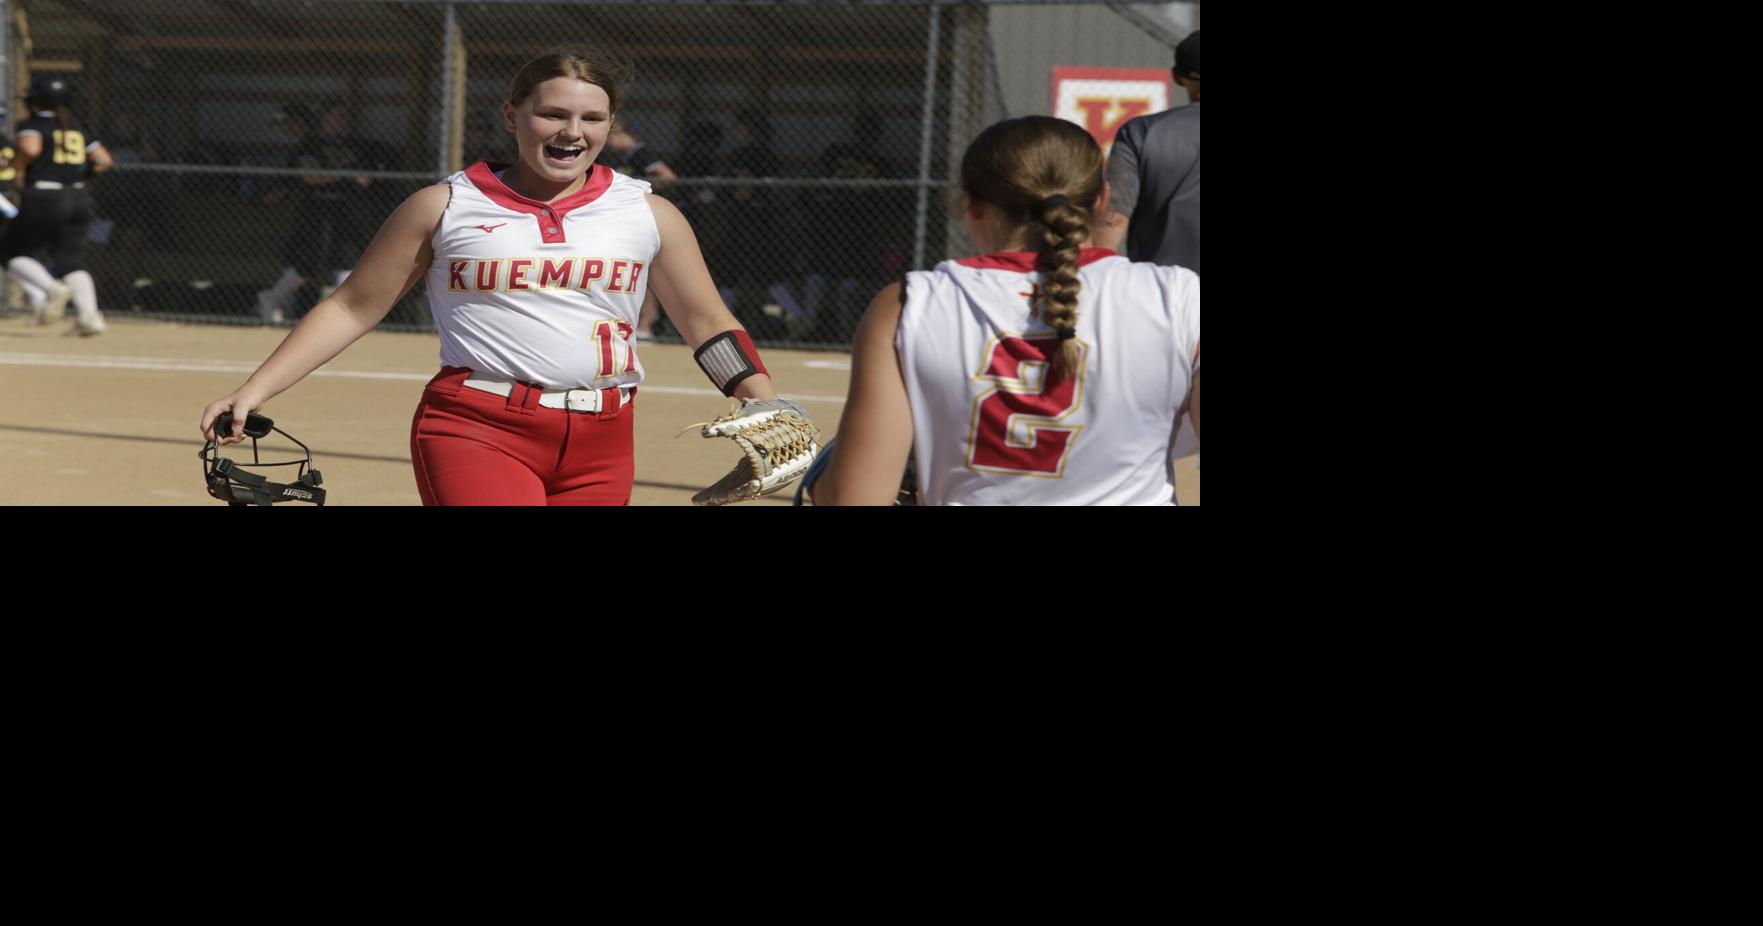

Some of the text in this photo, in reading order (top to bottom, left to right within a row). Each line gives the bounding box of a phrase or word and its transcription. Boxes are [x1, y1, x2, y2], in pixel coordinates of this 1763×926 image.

[52, 129, 86, 164] 19
[448, 256, 645, 295] KUEMPER
[592, 318, 639, 381] 17
[966, 331, 1088, 478] 2
